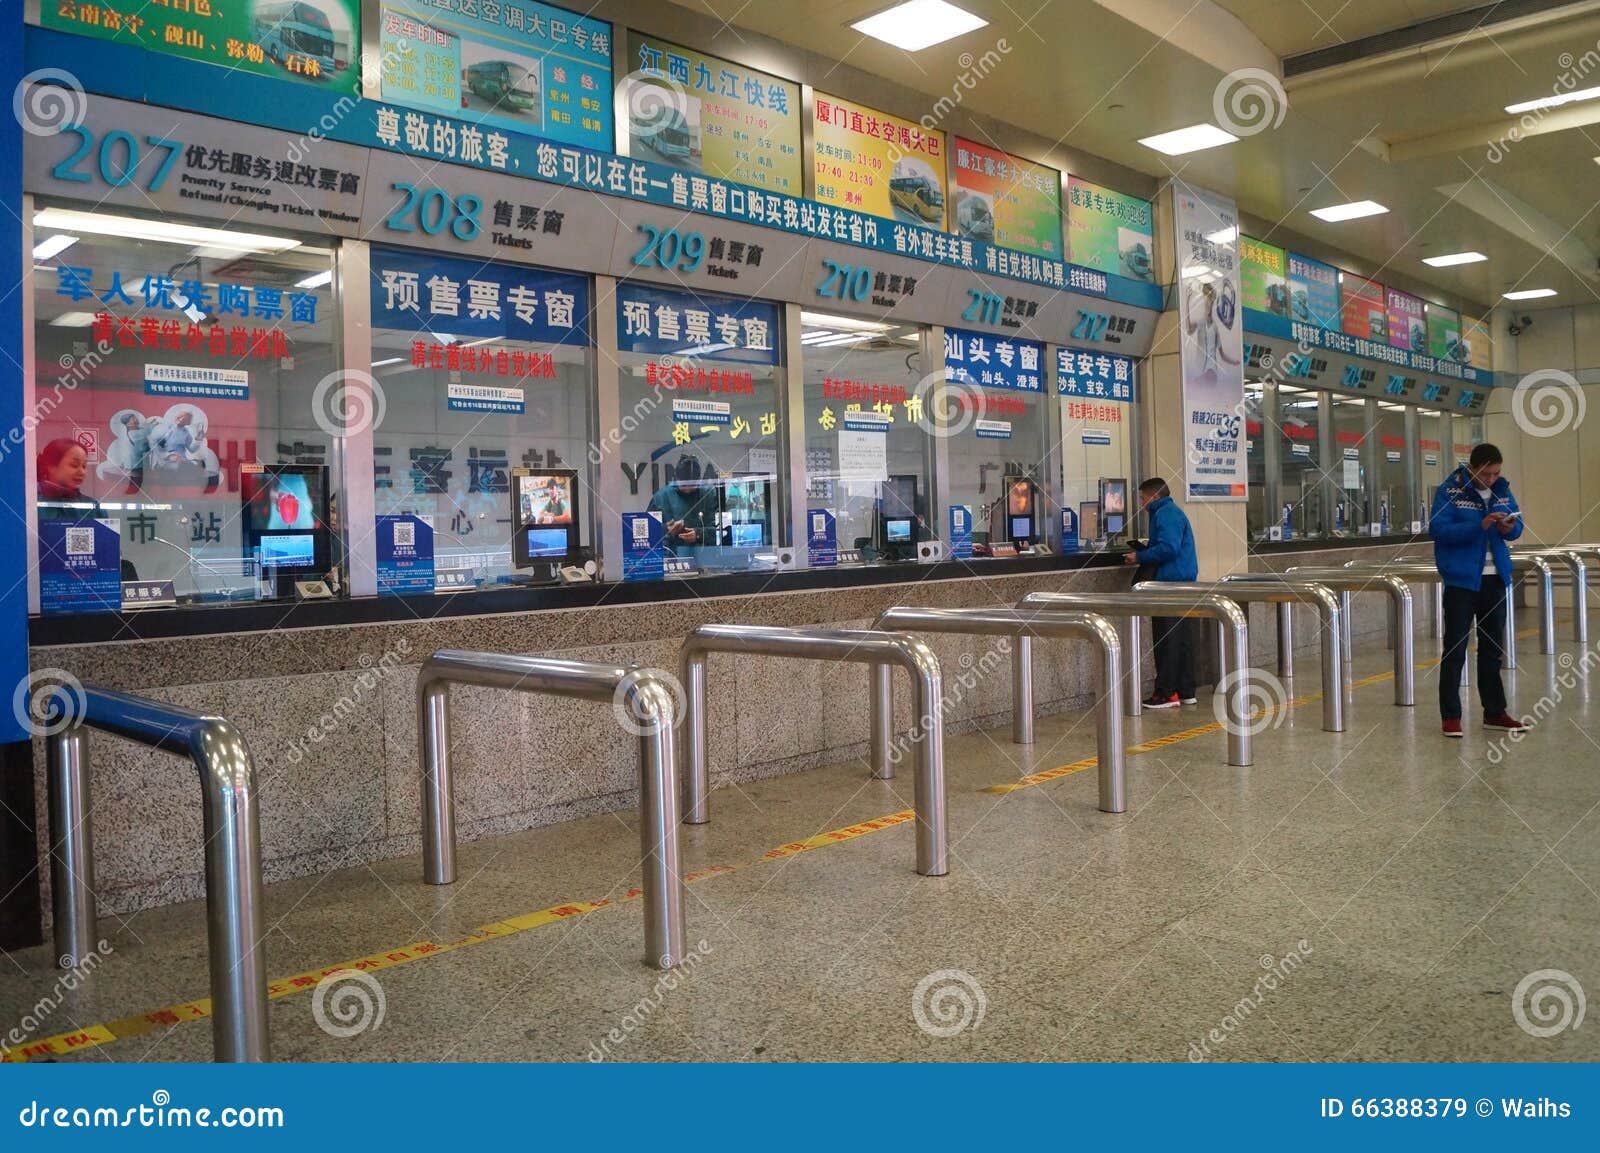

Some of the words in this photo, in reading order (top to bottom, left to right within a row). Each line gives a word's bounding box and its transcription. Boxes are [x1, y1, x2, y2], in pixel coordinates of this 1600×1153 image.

[638, 43, 788, 115] 江西九江快线
[52, 122, 184, 192] 207
[182, 173, 226, 190] Priority
[230, 181, 272, 197] Service
[282, 203, 315, 217] Ticket
[318, 208, 360, 224] Window
[385, 181, 485, 242] 208
[493, 199, 566, 237] 售票窗
[491, 231, 534, 251] Tickets
[631, 223, 706, 273] 209
[708, 237, 765, 267] 售票窗
[56, 264, 319, 325] 军人优先购票窗
[706, 264, 739, 280] Tickets
[815, 258, 872, 302] 210
[381, 268, 576, 329] 预售票专窗
[91, 312, 291, 360] 请在黄线外自觉排队
[622, 299, 770, 351] 预售票专窗
[410, 340, 558, 380] 请在黄线外自觉排队
[943, 331, 1039, 371] 汕头专窗
[1057, 350, 1129, 382] 宝安专窗
